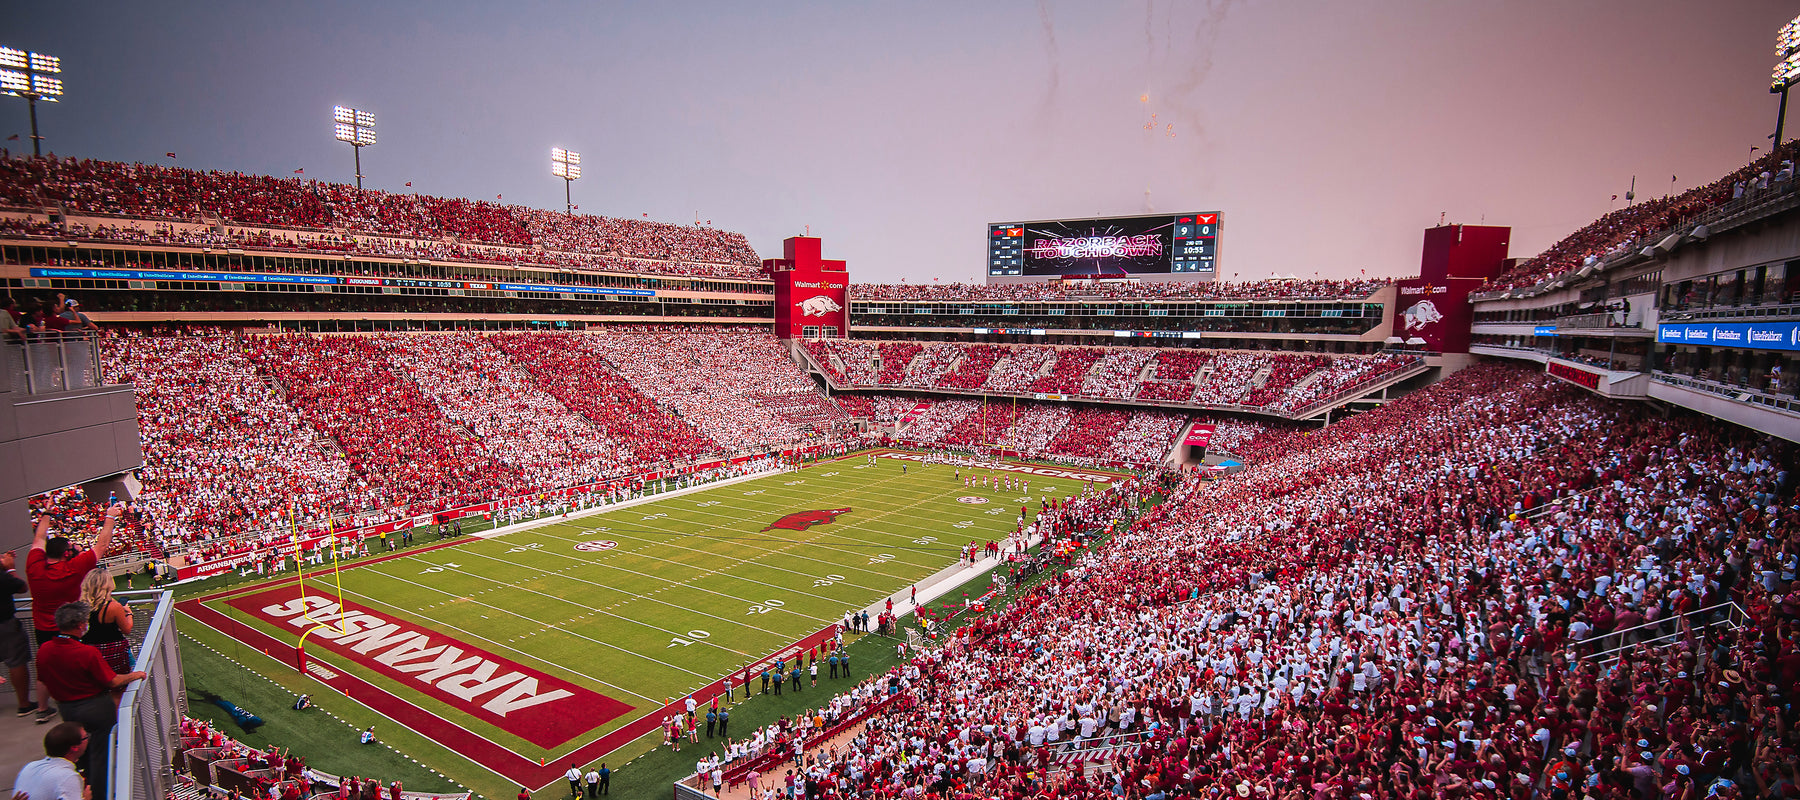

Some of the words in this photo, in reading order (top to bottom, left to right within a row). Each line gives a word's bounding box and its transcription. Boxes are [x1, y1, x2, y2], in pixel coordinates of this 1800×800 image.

[1181, 226, 1188, 236] 9
[1202, 225, 1210, 235] 0
[1034, 234, 1163, 249] RAZORBACK
[1032, 245, 1163, 259] TOUCHDOWN
[1183, 246, 1204, 254] 10:55
[1175, 263, 1182, 271] 3
[1189, 263, 1196, 271] 4
[794, 281, 820, 289] Walmart
[1401, 286, 1425, 295] Walmart
[414, 516, 432, 525] ESPN
[912, 535, 938, 545] 50
[867, 553, 897, 564] 40
[814, 574, 846, 587] 30
[747, 599, 786, 616] 20
[671, 631, 711, 648] 10
[261, 595, 576, 718] ARKANSAS
[1153, 740, 1160, 749] 5
